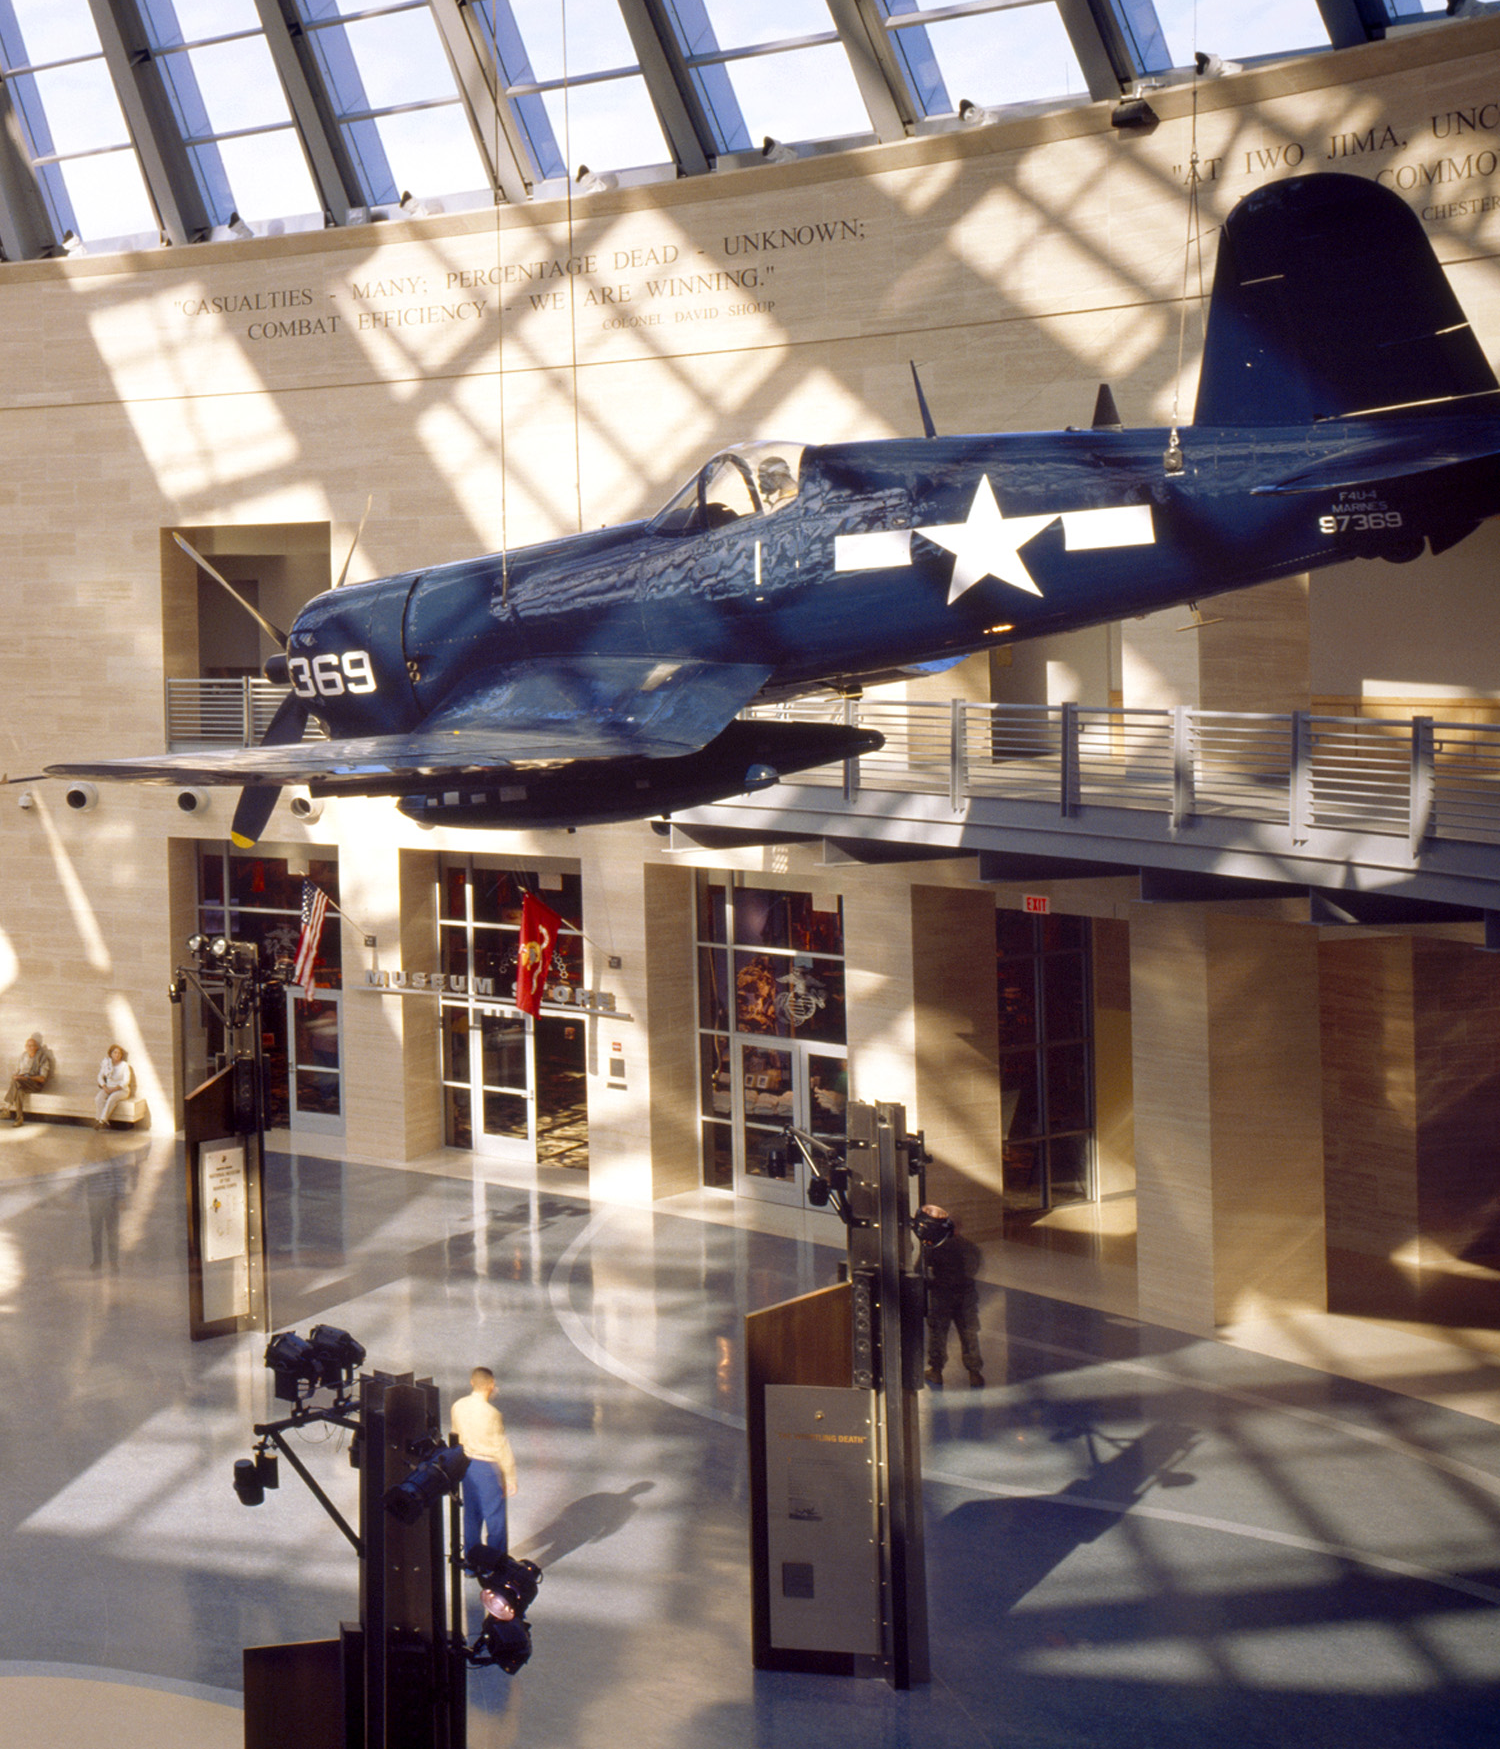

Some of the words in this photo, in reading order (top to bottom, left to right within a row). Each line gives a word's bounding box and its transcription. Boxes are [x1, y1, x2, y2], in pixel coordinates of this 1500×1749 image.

[1172, 157, 1222, 186] "AT
[1244, 142, 1304, 174] IWO
[1327, 125, 1408, 160] JIMA,
[1431, 103, 1500, 139] UNC
[1376, 150, 1500, 191] COMMO
[1422, 195, 1500, 221] CHESTER
[174, 287, 313, 316] "CASUALTIES
[352, 275, 427, 300] MANY;
[446, 254, 598, 289] PERCENTAGE
[614, 244, 679, 270] DEAD
[723, 218, 866, 255] UNKNOWN;
[247, 315, 341, 340] COMBAT
[358, 300, 487, 330] EFFICIENCY
[529, 291, 565, 311] WE
[582, 286, 631, 307] ARE
[646, 265, 775, 298] WINNING."
[602, 314, 664, 331] COLONEL
[675, 307, 719, 324] DAVID
[728, 300, 776, 317] SHOUP
[1331, 501, 1388, 514] MARINES
[1339, 490, 1377, 501] F4U-4
[1319, 512, 1402, 534] 97369
[288, 650, 378, 698] 369
[1026, 896, 1048, 912] EXIT
[365, 969, 495, 997] MUSEUM
[511, 981, 616, 1012] ORE
